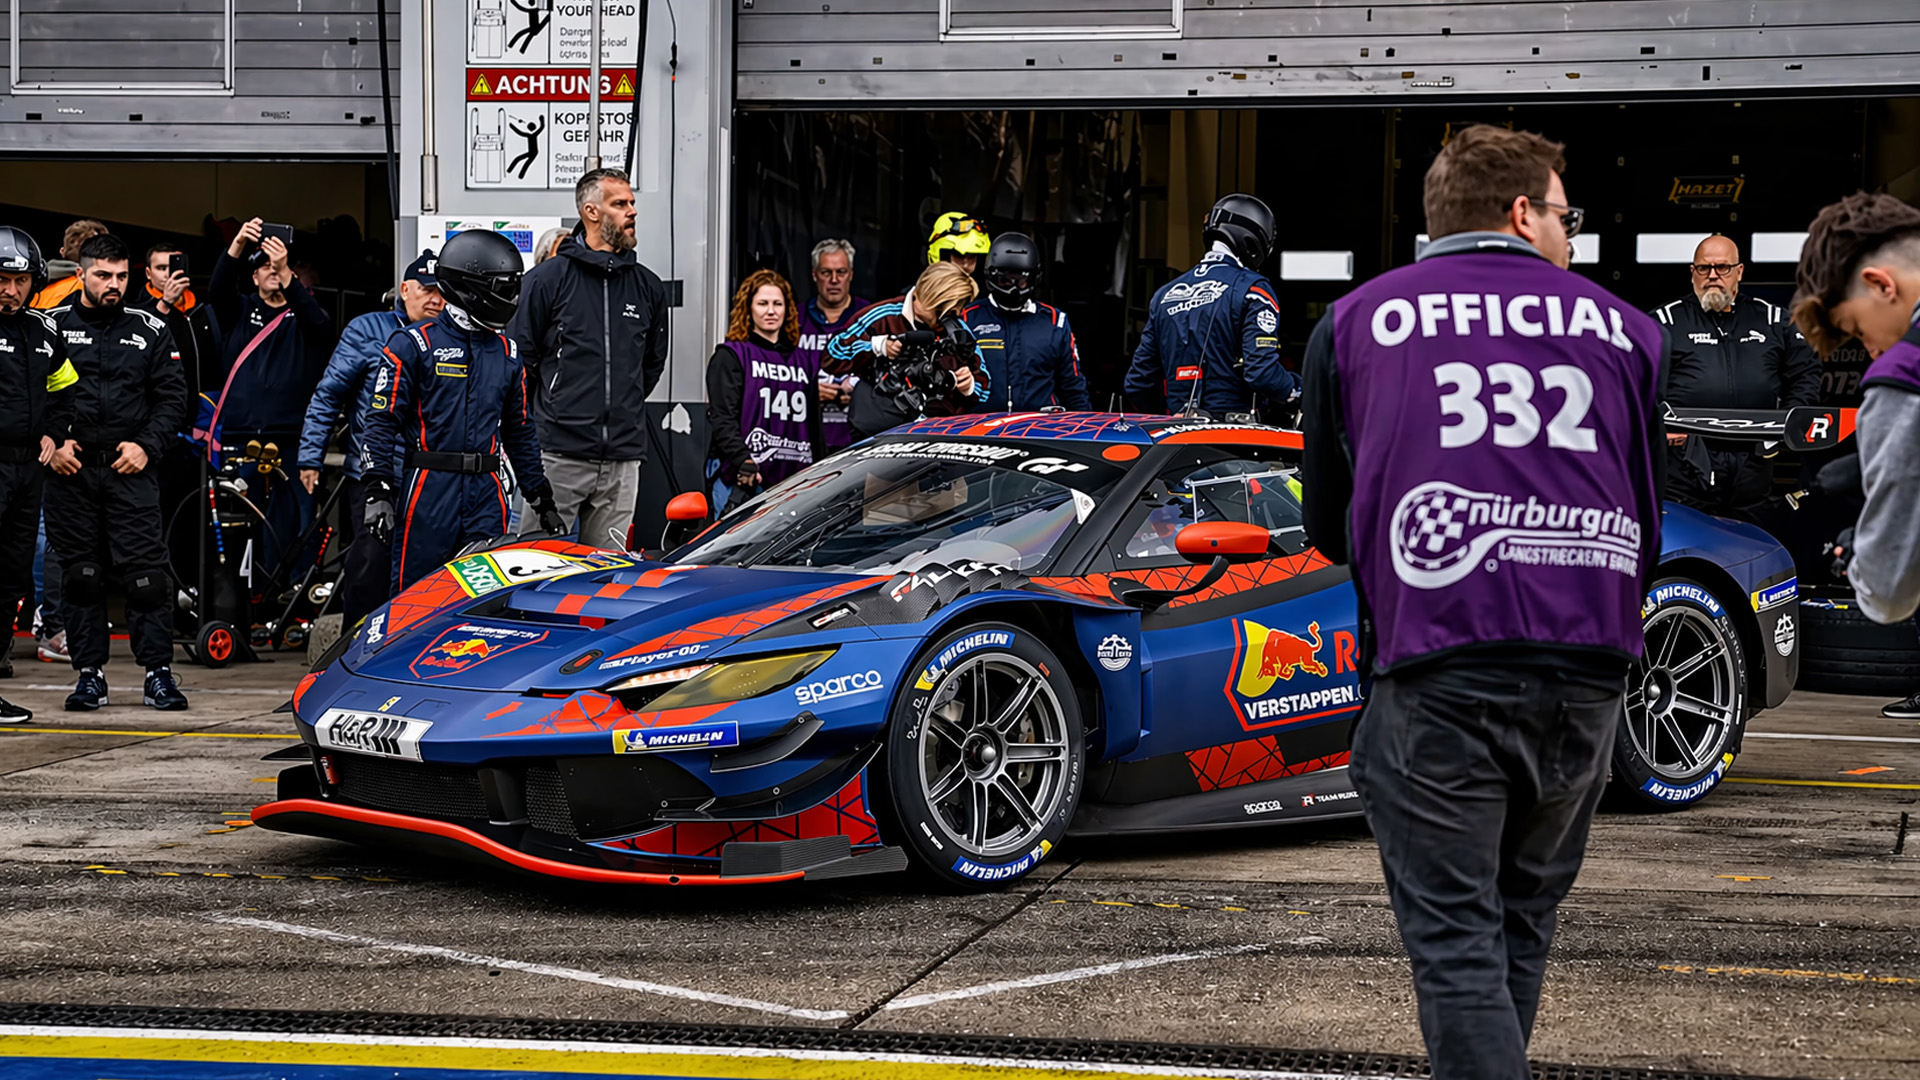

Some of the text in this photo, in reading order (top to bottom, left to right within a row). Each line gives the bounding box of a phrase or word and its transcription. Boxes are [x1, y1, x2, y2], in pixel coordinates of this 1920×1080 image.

[556, 5, 635, 16] YOUR HEAD
[1371, 293, 1633, 352] OFFICIAL
[751, 360, 809, 385] MEDIA
[759, 387, 808, 422] 149
[1433, 362, 1599, 453] 332
[1468, 495, 1642, 550] nürburgring
[239, 539, 253, 588] 4
[938, 633, 1009, 669] MICHELIN
[1333, 630, 1361, 674] R
[795, 670, 884, 705] sparco
[1244, 683, 1366, 720] VERSTAPPEN.
